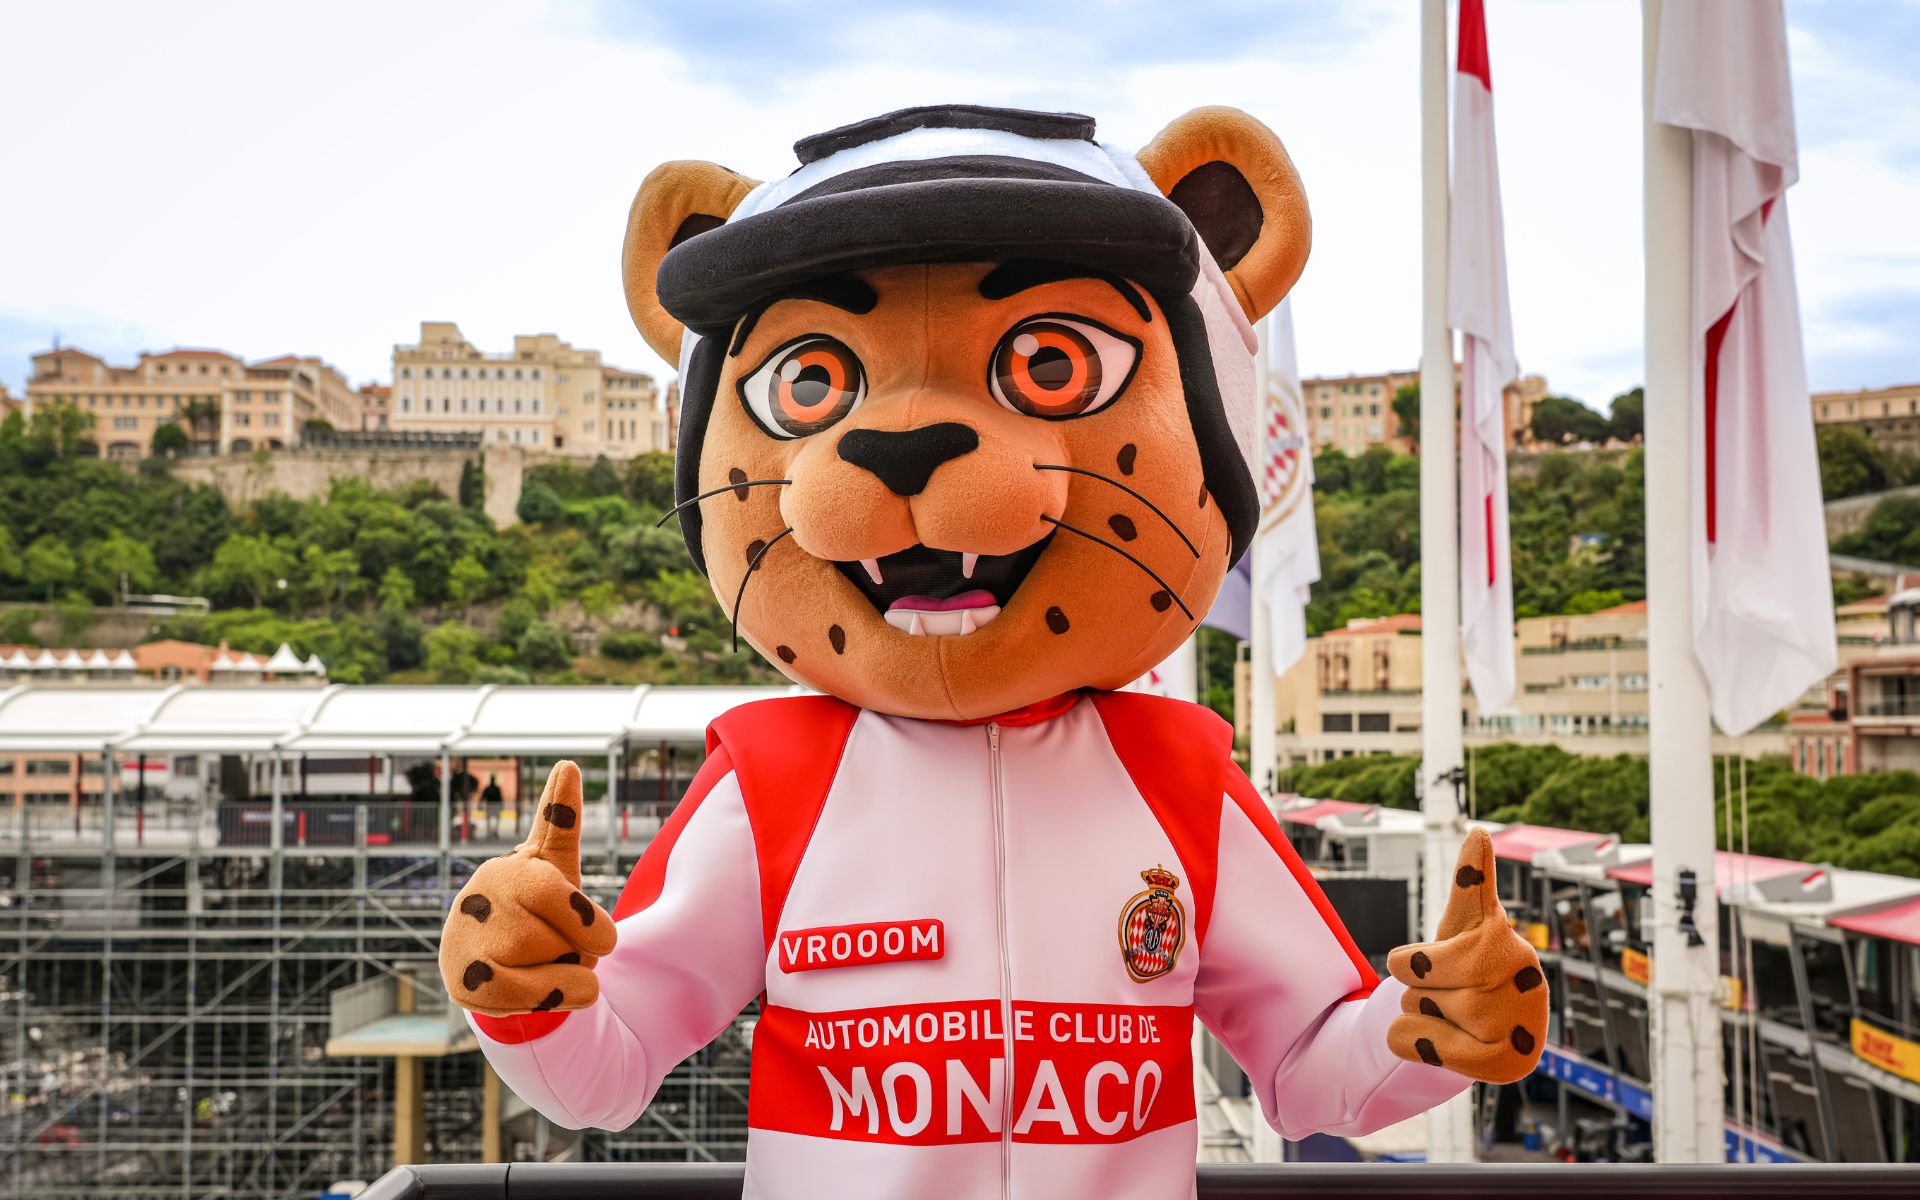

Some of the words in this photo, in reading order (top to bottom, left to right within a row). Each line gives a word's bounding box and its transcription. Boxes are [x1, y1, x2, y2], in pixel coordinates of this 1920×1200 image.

[782, 925, 939, 965] VROOOM
[804, 1010, 1035, 1050] AUTOMOBILE
[1049, 1012, 1133, 1044] CLUB
[1138, 1014, 1161, 1044] DE
[817, 1059, 1162, 1137] MONACO
